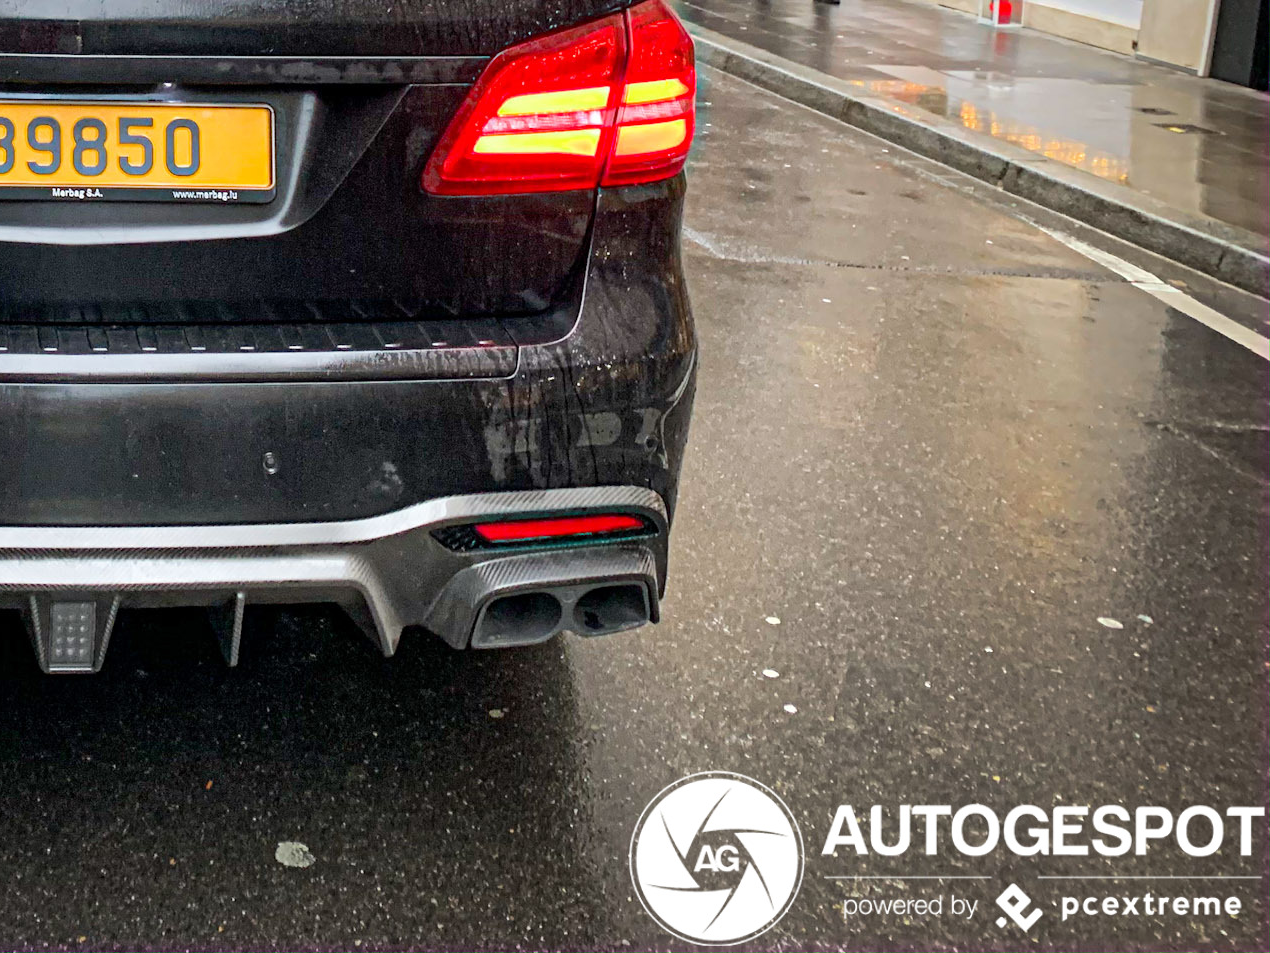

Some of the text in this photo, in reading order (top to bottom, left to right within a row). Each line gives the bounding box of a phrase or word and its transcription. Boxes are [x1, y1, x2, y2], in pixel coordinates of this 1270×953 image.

[52, 187, 103, 199] Merbag S.A.
[172, 190, 238, 202] www.merbag.lu
